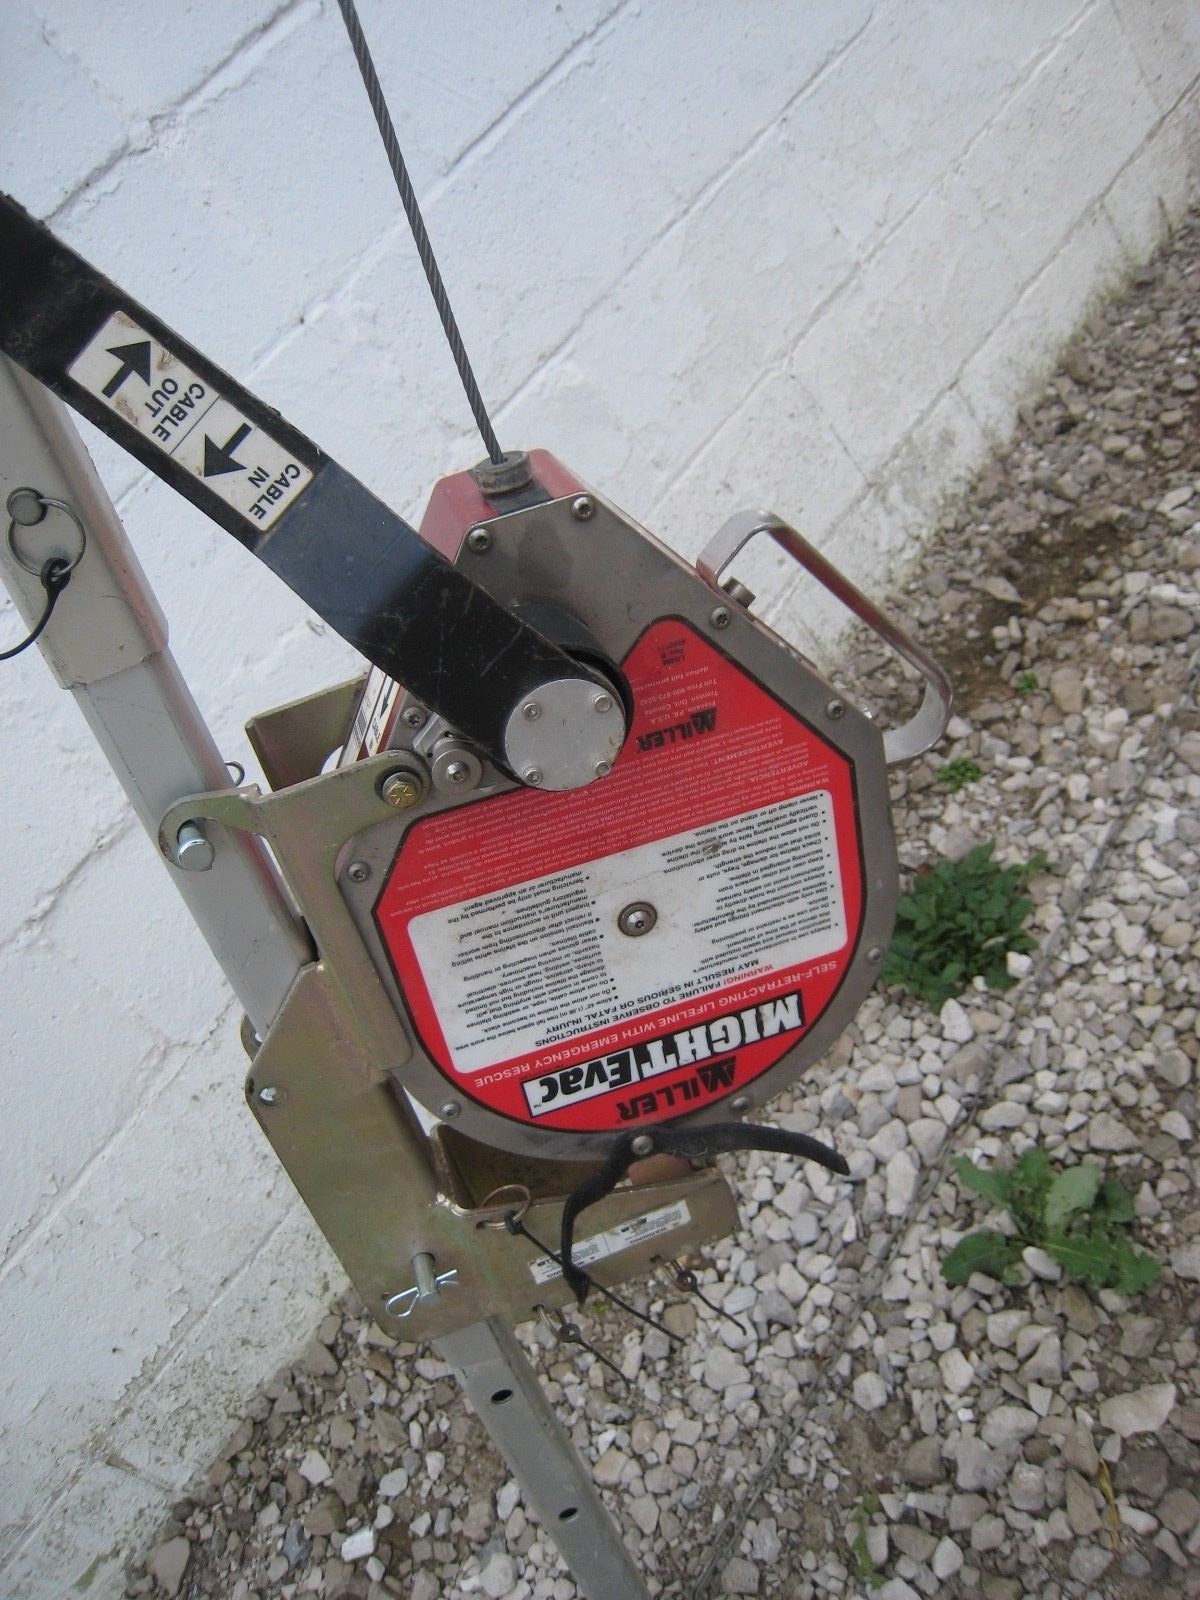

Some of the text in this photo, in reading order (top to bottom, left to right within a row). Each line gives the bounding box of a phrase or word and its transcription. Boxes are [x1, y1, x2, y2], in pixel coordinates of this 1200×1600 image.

[145, 378, 178, 417] OUT
[152, 383, 205, 442] CABLE
[247, 466, 270, 488] IN
[248, 464, 300, 519] CABLE
[635, 707, 716, 752] MILLER
[473, 959, 837, 1087] SELF-RETRACTING LIFELINE WITH EMERGENCY RESCUE
[534, 963, 773, 1047] WARNING! FAILURE TO OBSERVE INSTRUCTIONS
[543, 958, 759, 1034] MAY RESULT IN SERIOUS OR FATAL INJURY
[614, 1055, 735, 1122] MILLER
